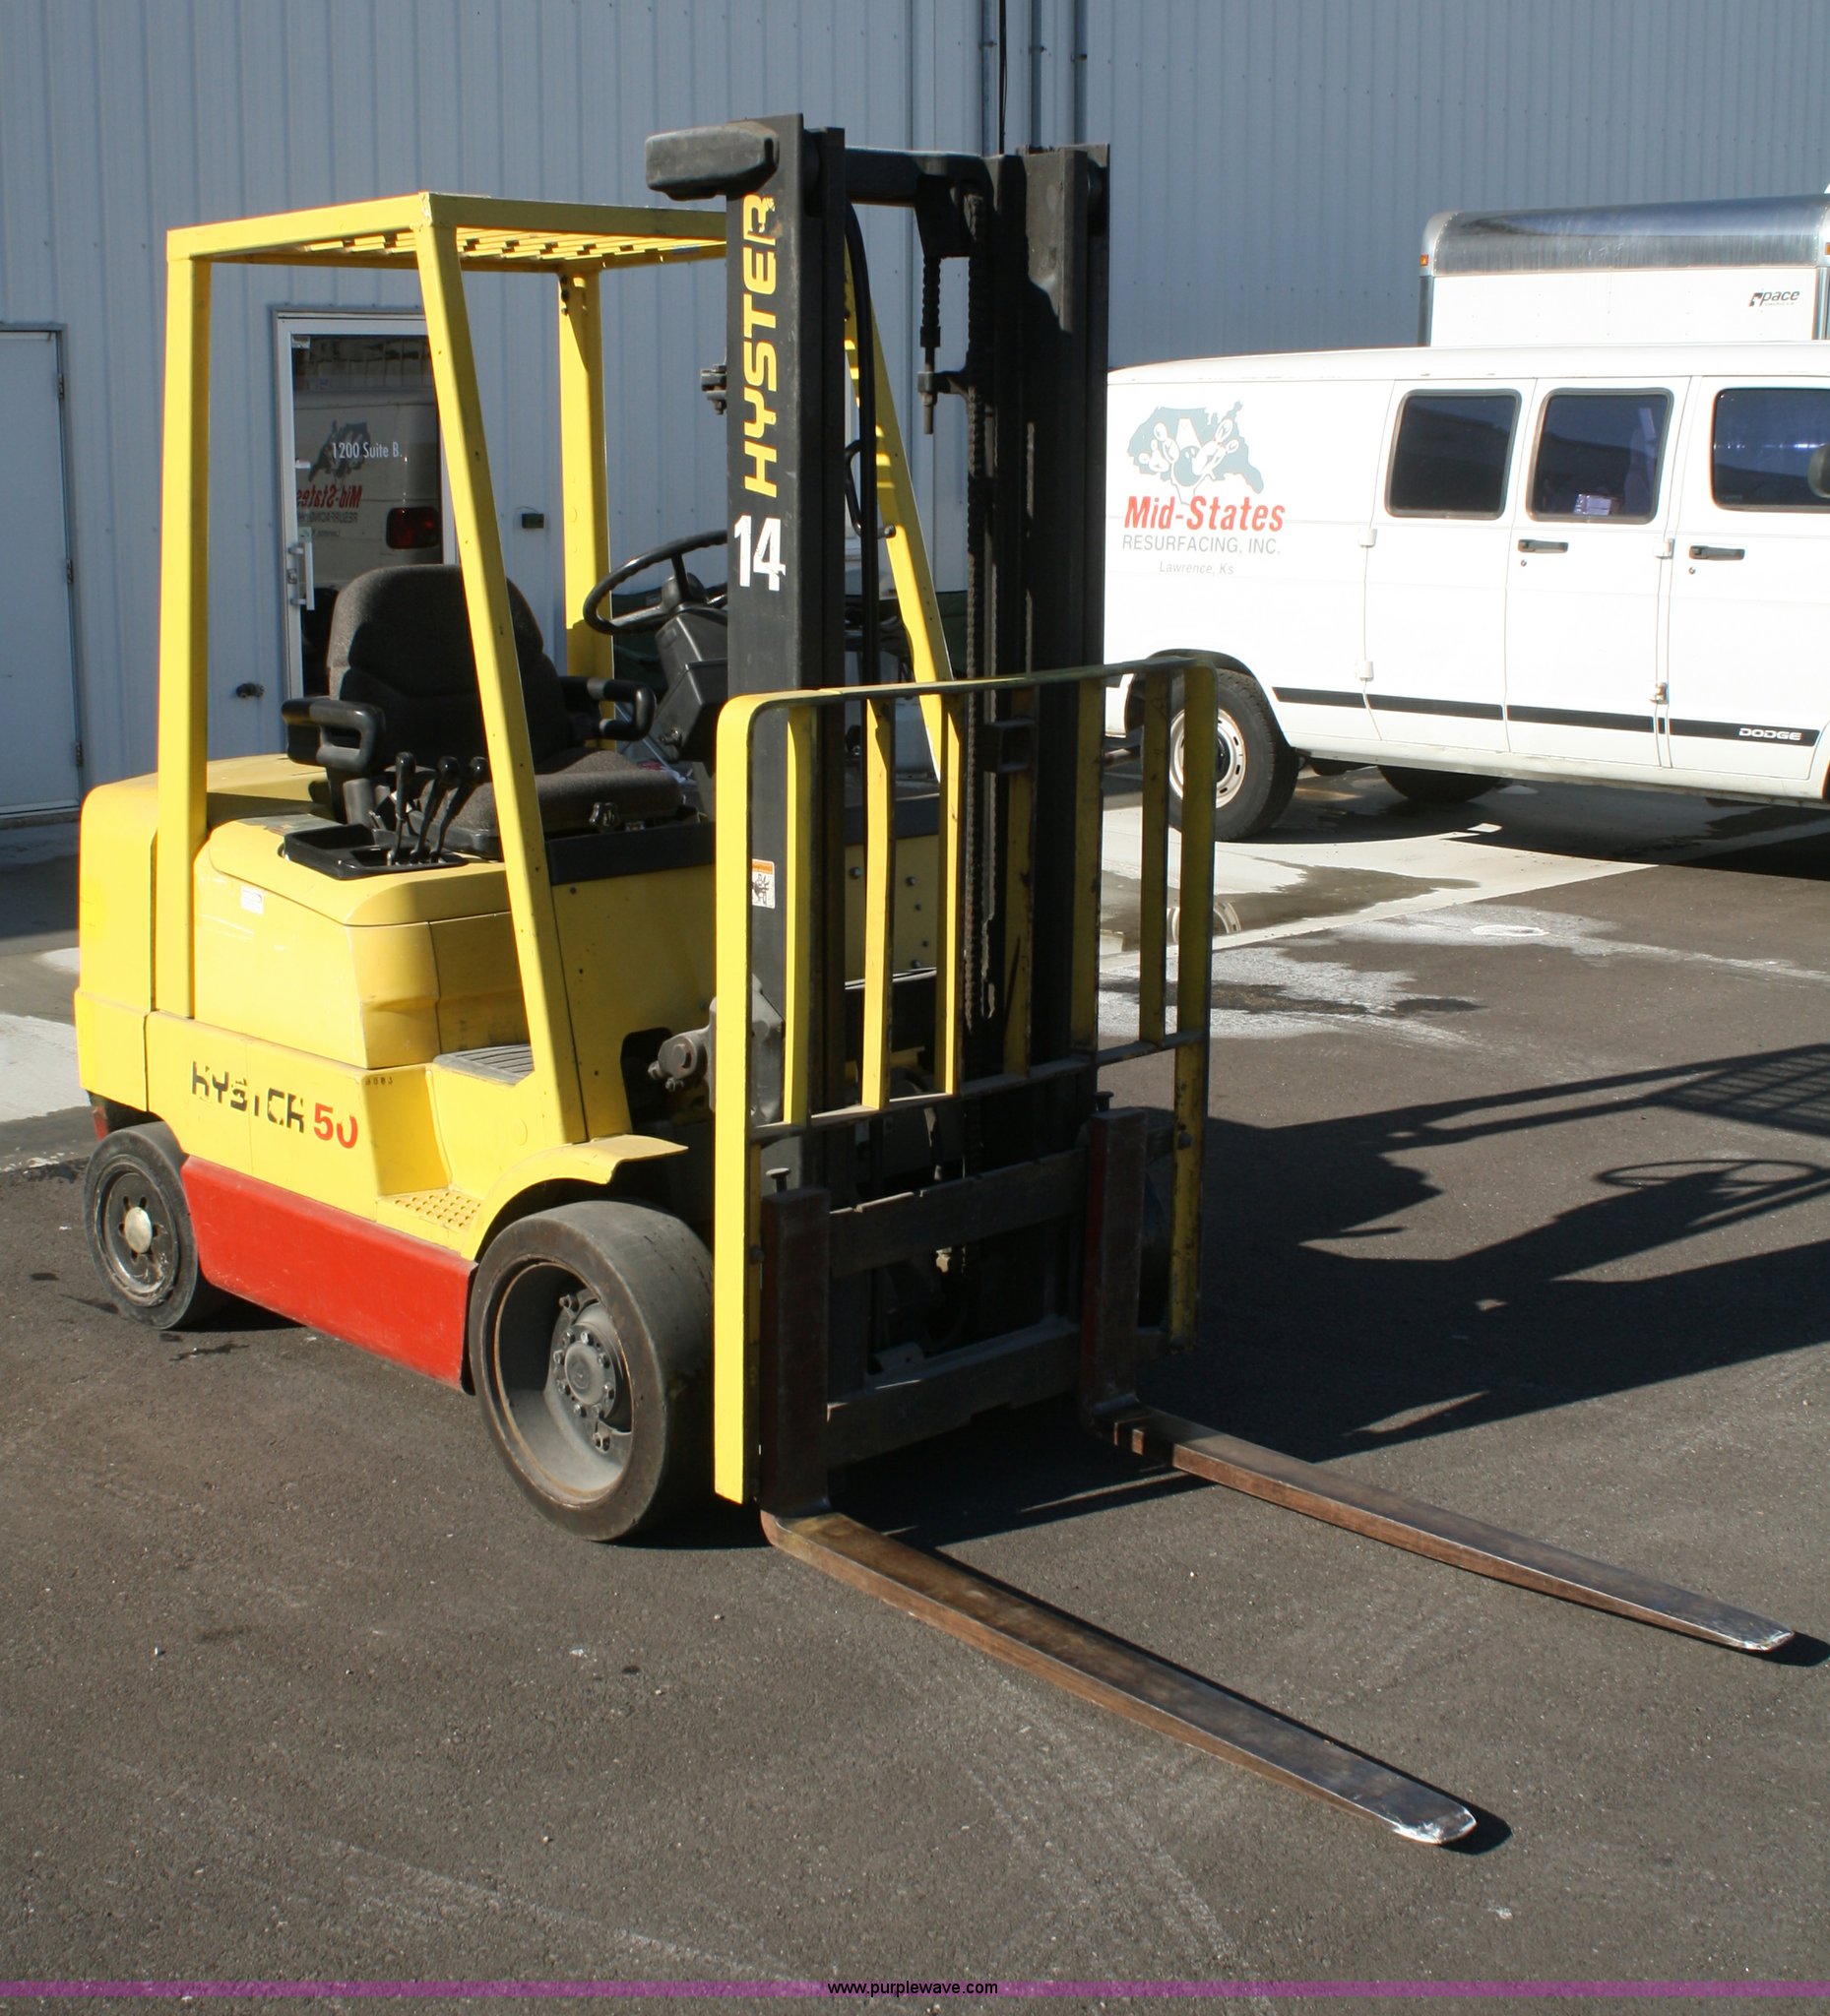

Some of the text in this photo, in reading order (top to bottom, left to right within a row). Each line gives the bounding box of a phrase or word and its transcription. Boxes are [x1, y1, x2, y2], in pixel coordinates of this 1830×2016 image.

[1759, 290, 1800, 307] pace
[743, 194, 778, 498] HYSTER
[333, 442, 360, 459] 1200
[362, 442, 389, 459] Suite
[1124, 495, 1286, 533] Mid-States
[734, 514, 787, 592] 14
[1122, 535, 1281, 554] RESURFACING, INC.
[1160, 561, 1234, 577] Lawrence, Ks
[1738, 727, 1801, 740] DODGE
[313, 1102, 358, 1150] 50
